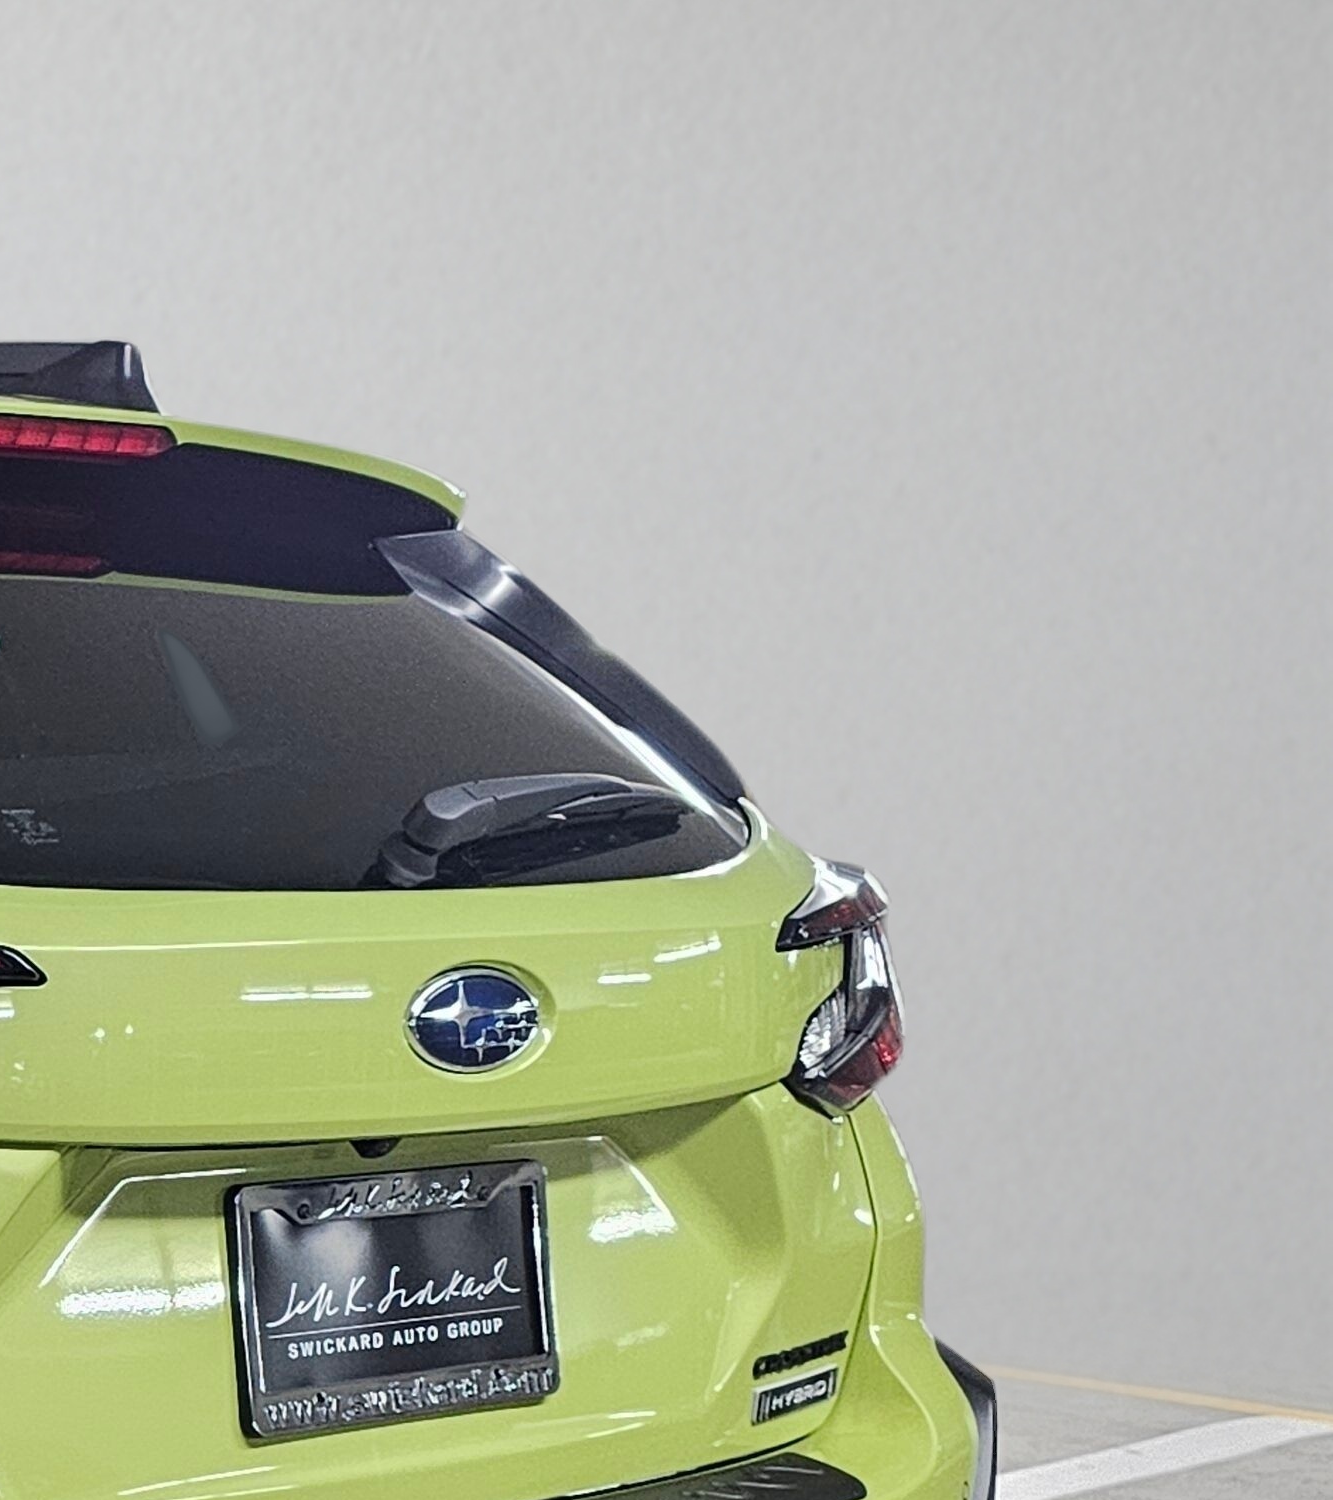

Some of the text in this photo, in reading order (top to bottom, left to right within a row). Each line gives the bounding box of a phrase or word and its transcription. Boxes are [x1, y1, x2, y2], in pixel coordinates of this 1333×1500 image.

[286, 1316, 505, 1360] SWICKARD AUTO GROUP
